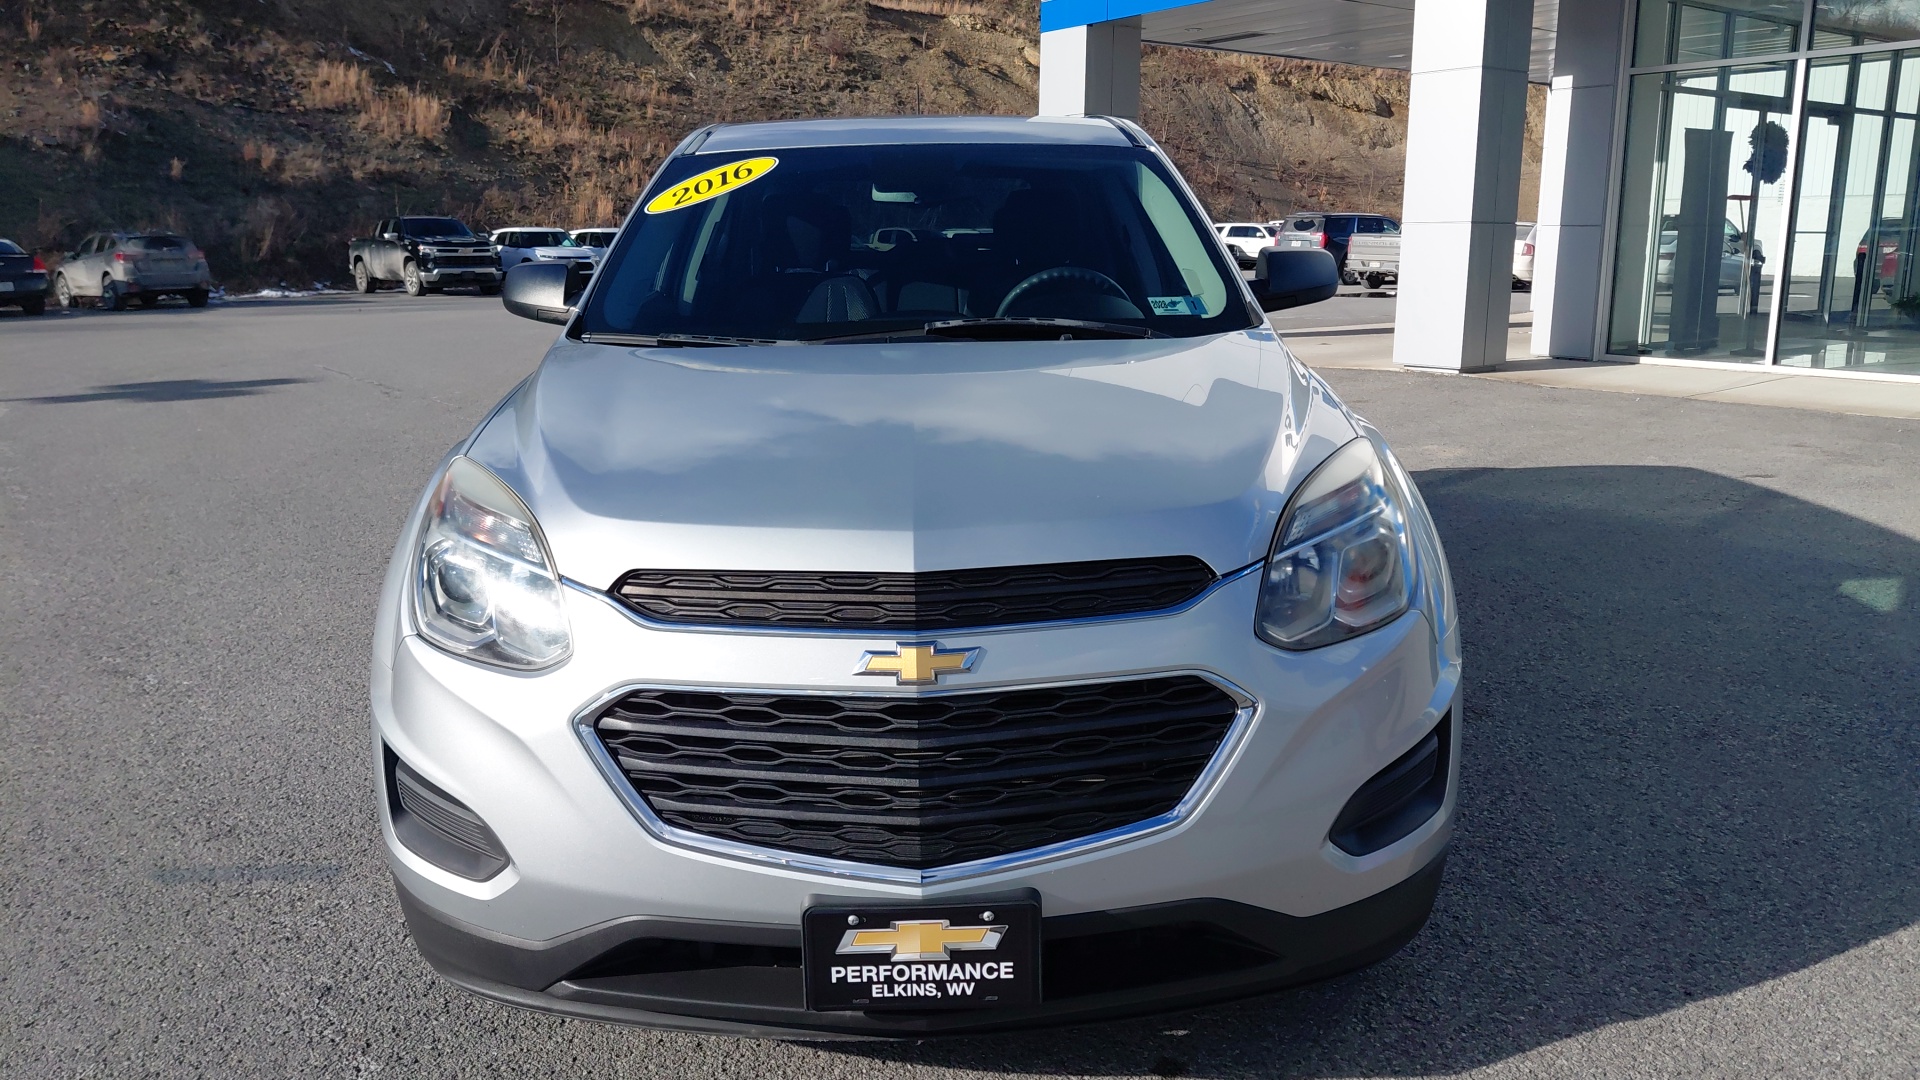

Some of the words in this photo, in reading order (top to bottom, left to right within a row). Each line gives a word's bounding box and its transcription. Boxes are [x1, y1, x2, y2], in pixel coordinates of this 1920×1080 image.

[671, 161, 753, 206] 2016
[831, 962, 1014, 983] PERFORMANCE
[871, 982, 942, 998] ELKINS,
[946, 981, 976, 996] WV
